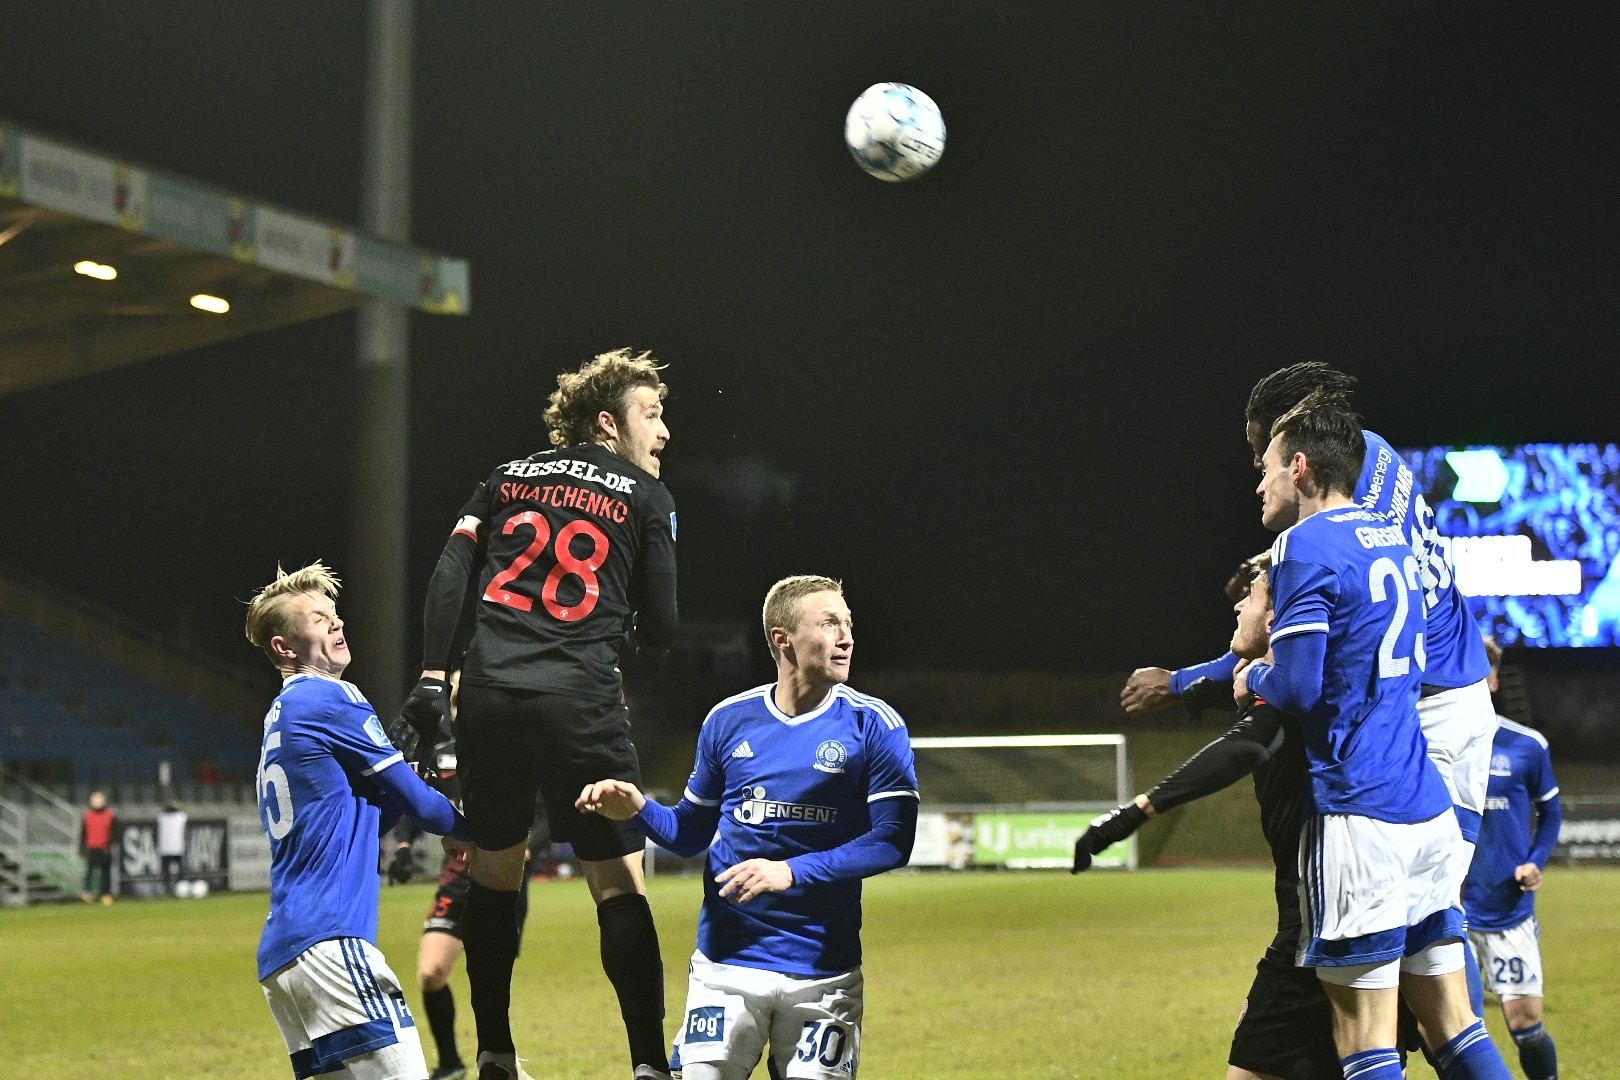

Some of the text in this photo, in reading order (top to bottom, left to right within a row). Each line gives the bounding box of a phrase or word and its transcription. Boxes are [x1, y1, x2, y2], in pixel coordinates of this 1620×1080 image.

[501, 483, 628, 523] SVIATCHENKO
[482, 510, 610, 622] 28
[255, 731, 294, 840] 5
[1493, 956, 1525, 984] 29
[798, 1020, 846, 1068] 30
